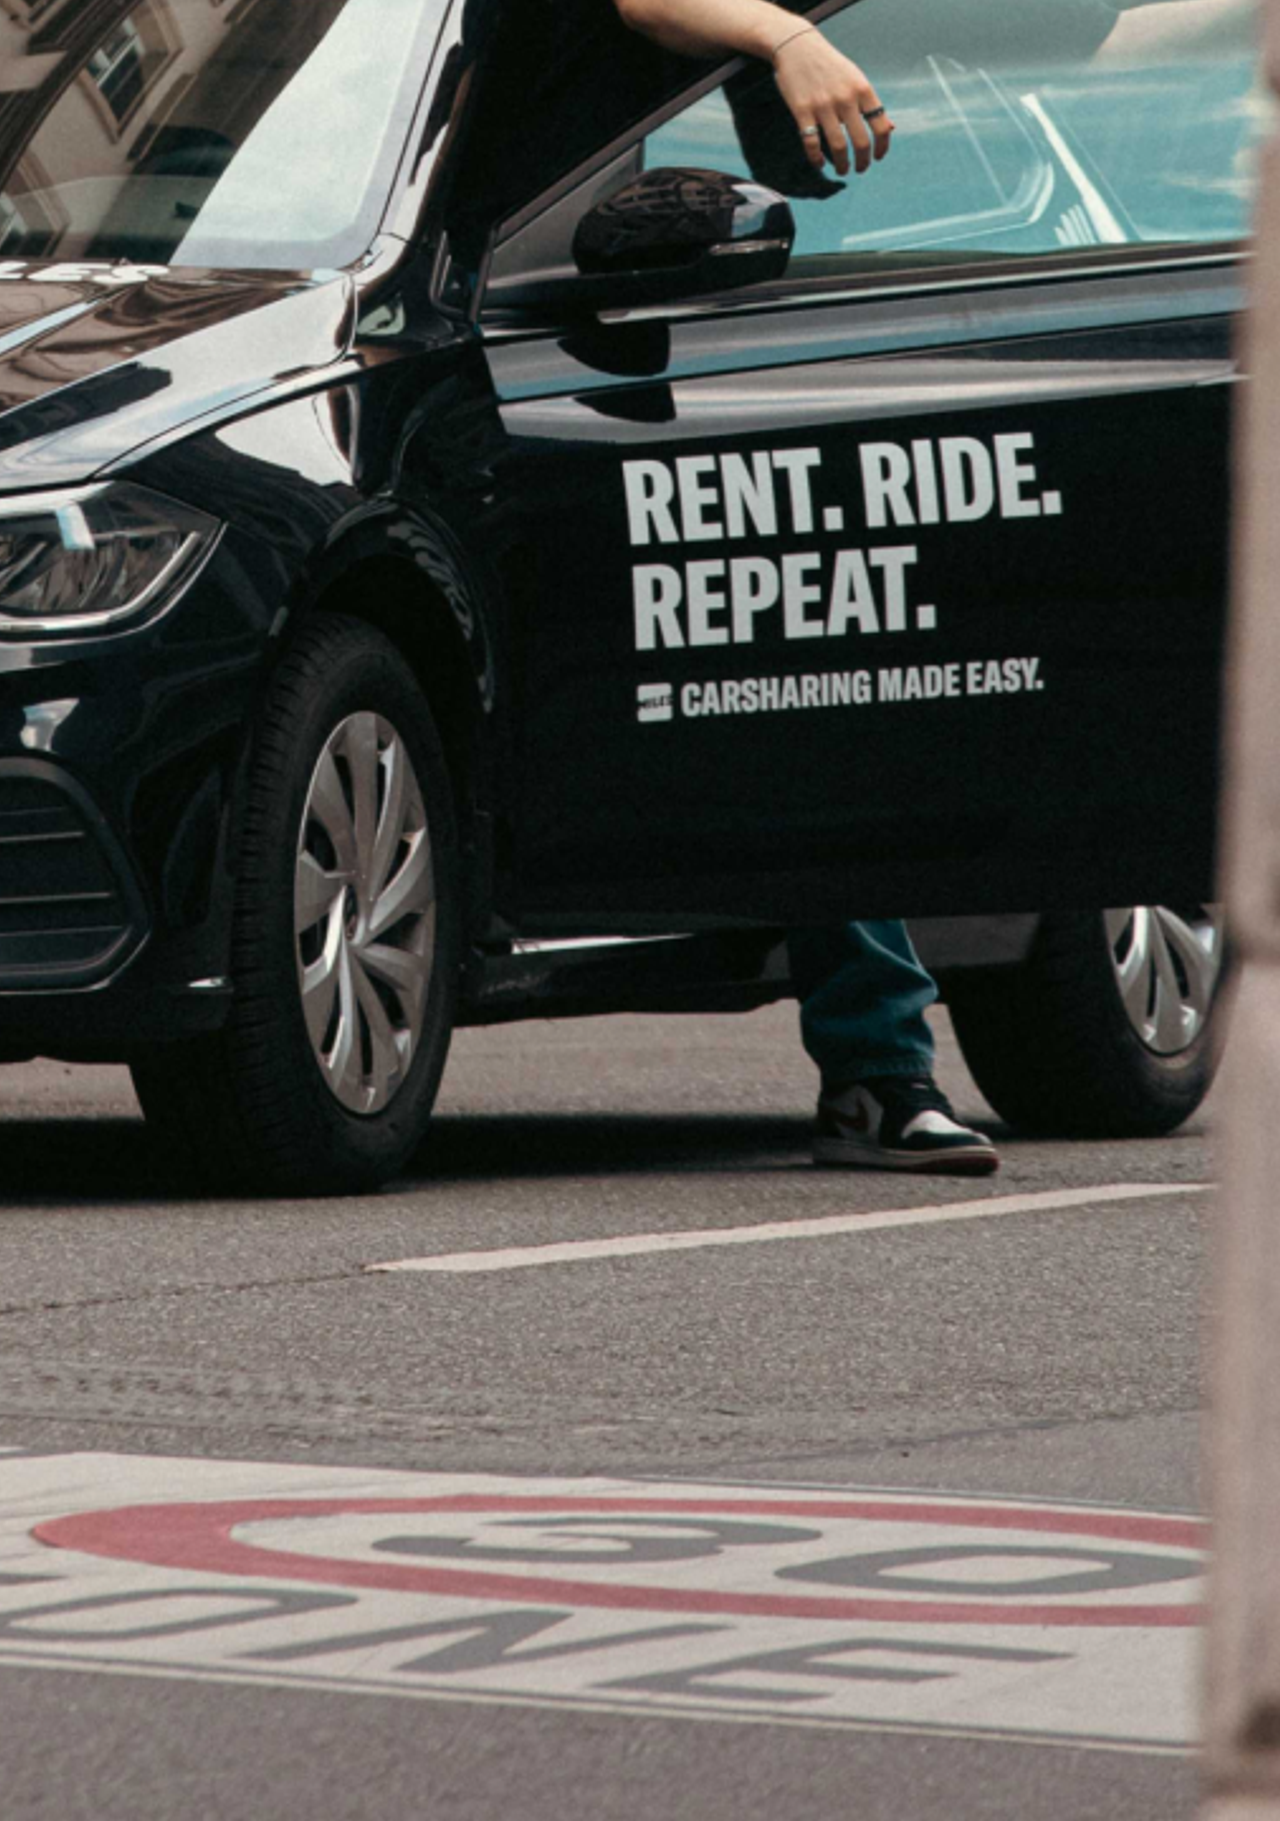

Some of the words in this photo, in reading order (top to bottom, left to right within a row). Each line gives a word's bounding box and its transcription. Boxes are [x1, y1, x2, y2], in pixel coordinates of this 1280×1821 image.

[622, 447, 844, 546] RENT.
[858, 431, 1063, 530] RIDE.
[632, 545, 937, 652] REPEAT.
[680, 669, 872, 718] CARSHARING
[877, 663, 961, 702] MADE
[966, 657, 1044, 695] EASY.
[370, 1517, 1207, 1596] 30
